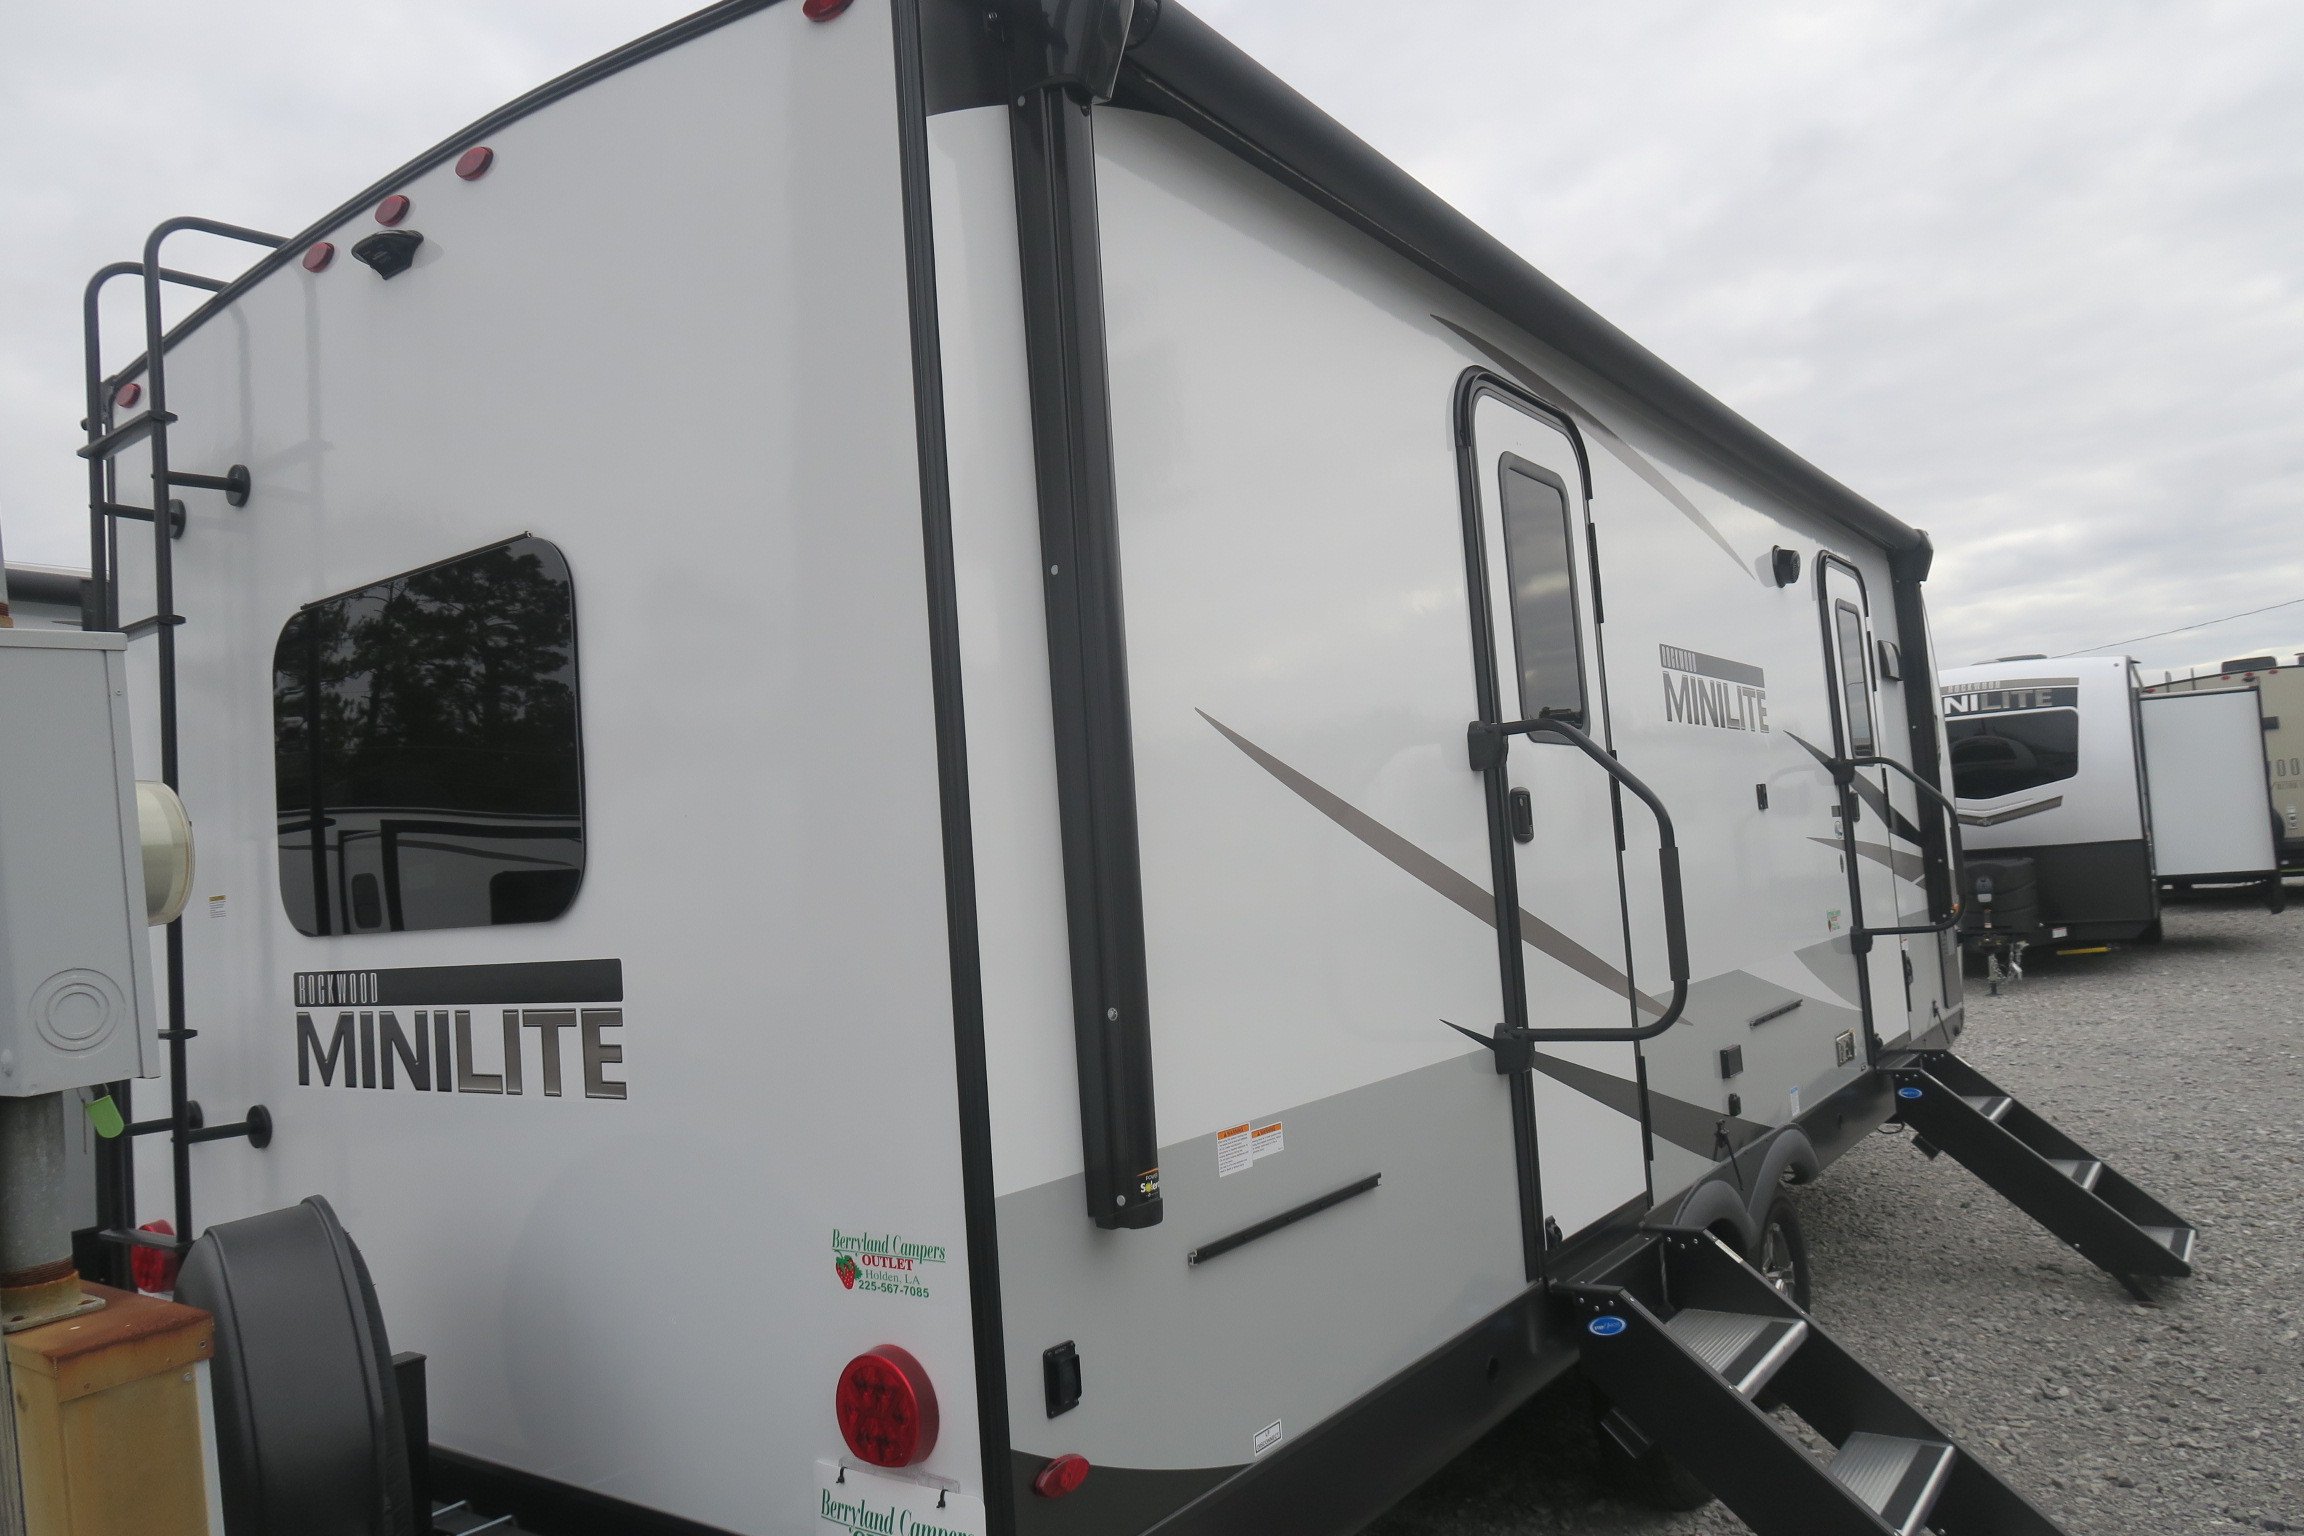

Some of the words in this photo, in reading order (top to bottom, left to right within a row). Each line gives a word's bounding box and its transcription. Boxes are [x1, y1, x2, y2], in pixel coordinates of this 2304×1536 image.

[1662, 671, 1769, 734] MINILITE
[1943, 688, 2053, 714] NILITE
[298, 972, 378, 1005] ROCKWOOD
[296, 1008, 627, 1100] MINILITE
[832, 1228, 889, 1254] Berryland
[893, 1234, 946, 1264] Campers
[861, 1254, 914, 1271] OUTLET
[858, 1279, 930, 1298] 225-567-7085
[905, 1273, 921, 1285] LA
[821, 1488, 895, 1535] Berryland
